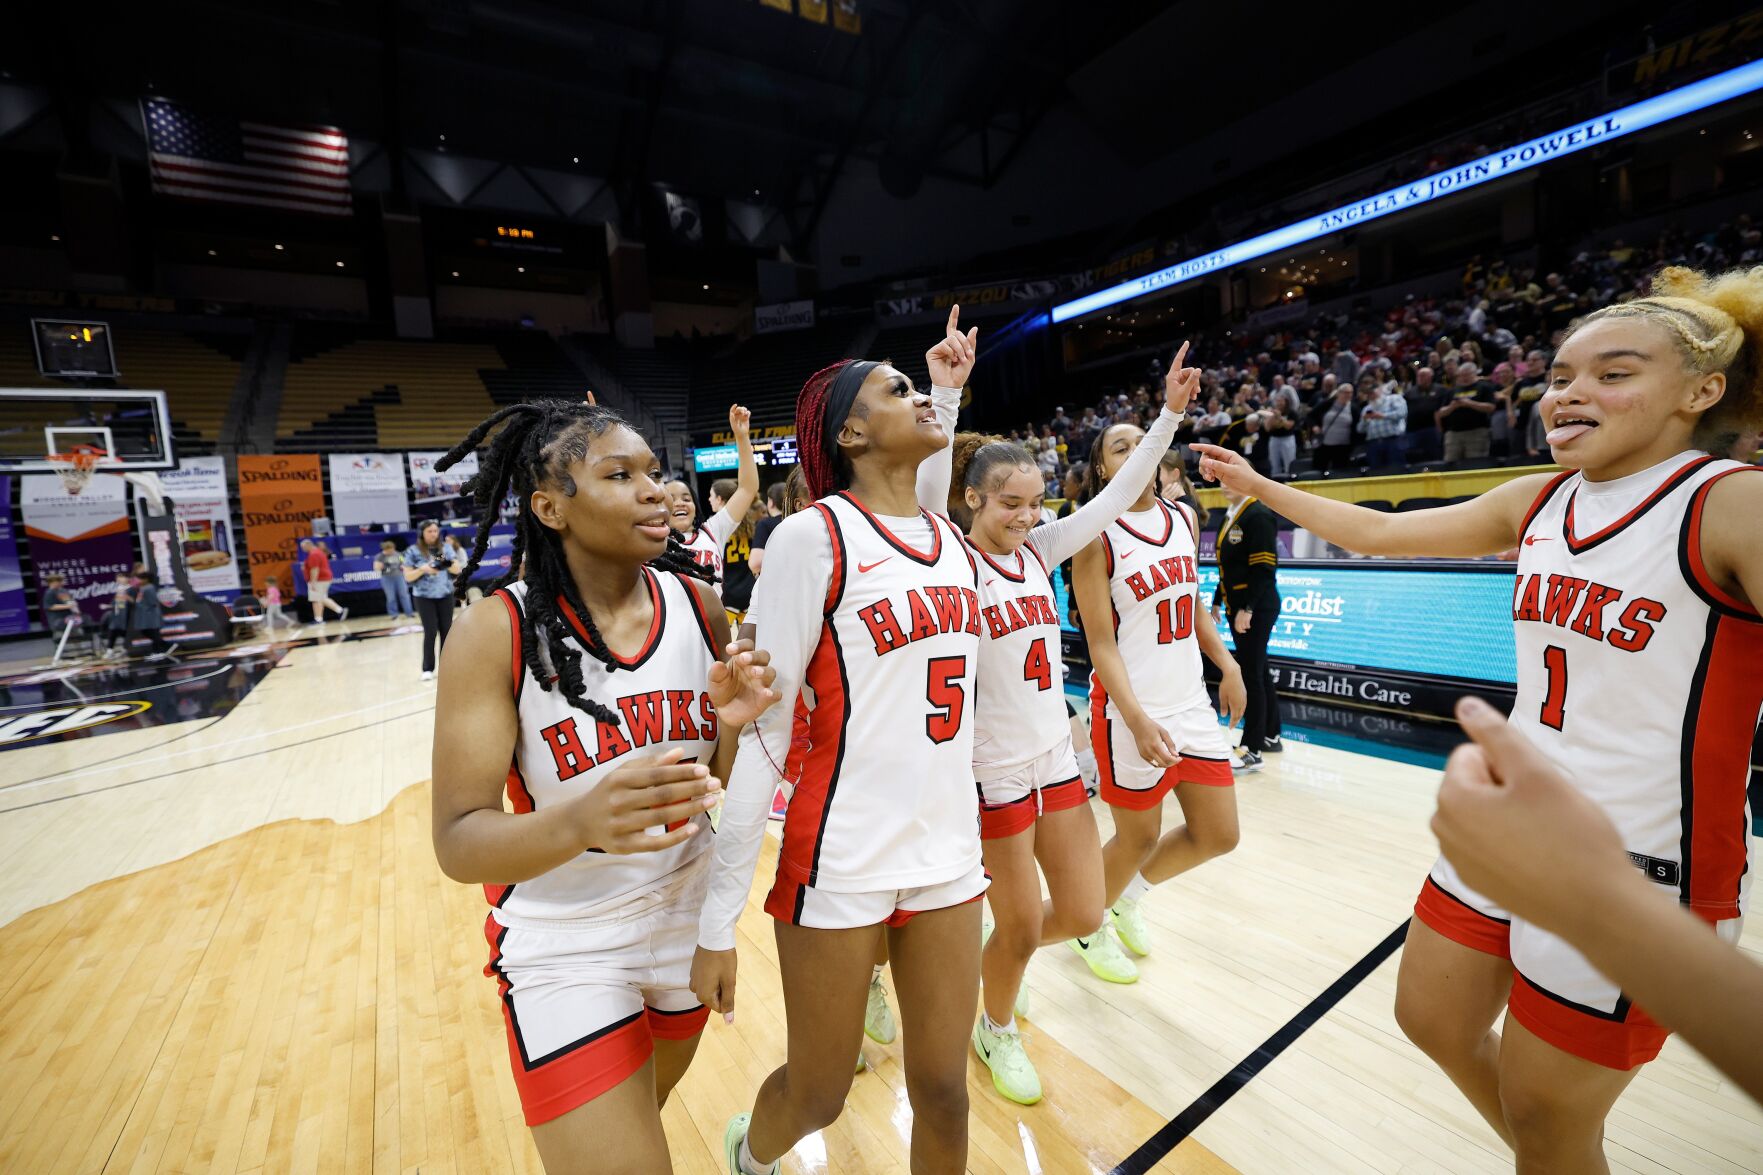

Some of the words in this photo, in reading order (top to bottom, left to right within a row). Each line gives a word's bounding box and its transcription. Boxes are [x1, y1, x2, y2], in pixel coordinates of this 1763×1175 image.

[1319, 195, 1399, 231] ANGELA
[1405, 187, 1420, 201] &
[1427, 161, 1491, 199] JOHN
[1501, 117, 1622, 169] POWELL
[1094, 248, 1156, 282] TIGERS
[1140, 270, 1177, 290] TEAM
[932, 287, 1009, 308] MIZZOU
[757, 310, 813, 330] SPALDING
[242, 468, 319, 484] SPALDING
[37, 558, 87, 569] WHERE
[726, 533, 751, 564] 24
[38, 563, 129, 578] EXCELLENCE
[40, 576, 86, 587] METS
[1124, 555, 1198, 603] HAWK
[1156, 593, 1194, 645] 10
[1024, 637, 1052, 692] 4
[926, 655, 967, 746] 5
[1288, 670, 1354, 697] Health
[1359, 680, 1412, 706] Care
[1540, 644, 1568, 733] 1
[540, 690, 718, 782] HAWKS
[1656, 866, 1667, 877] S
